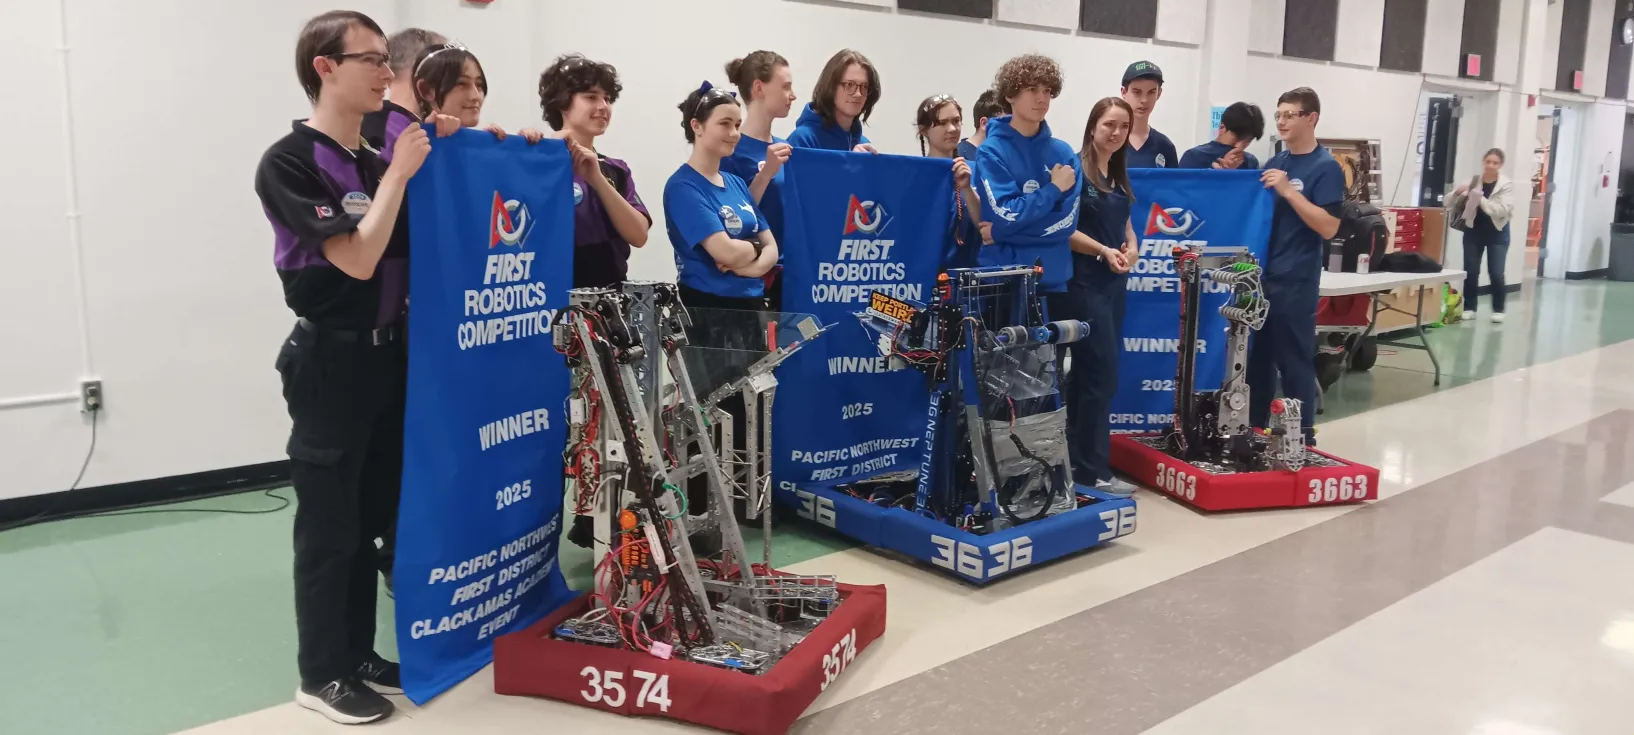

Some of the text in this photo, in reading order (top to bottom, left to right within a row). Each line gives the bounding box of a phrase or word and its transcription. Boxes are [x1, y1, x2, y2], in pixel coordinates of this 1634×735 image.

[837, 239, 895, 261] FIRST
[483, 252, 536, 285] FIRST
[818, 262, 906, 282] ROBOTICS
[464, 281, 547, 316] ROBOTICS
[1123, 337, 1207, 354] WINNR
[827, 356, 898, 375] WINNE
[841, 402, 873, 420] 2025
[1108, 413, 1145, 424] CIFIC
[478, 408, 550, 451] WINNER
[791, 437, 920, 464] PACIFIC NORTHWEST
[810, 453, 898, 481] FIRST DISTRICT
[919, 419, 936, 495] NEPTUNE
[495, 479, 532, 511] 2025
[1155, 463, 1198, 501] 3663
[1308, 474, 1368, 503] 3663
[796, 488, 984, 580] 36 36
[987, 505, 1137, 578] 36 36
[428, 549, 498, 585] PACIFIC
[451, 543, 551, 606] FIRST DISTRICT
[410, 588, 514, 640] CLACKAMAS
[477, 604, 521, 641] EVENT
[821, 628, 857, 692] 3574
[580, 666, 672, 713] 3574
